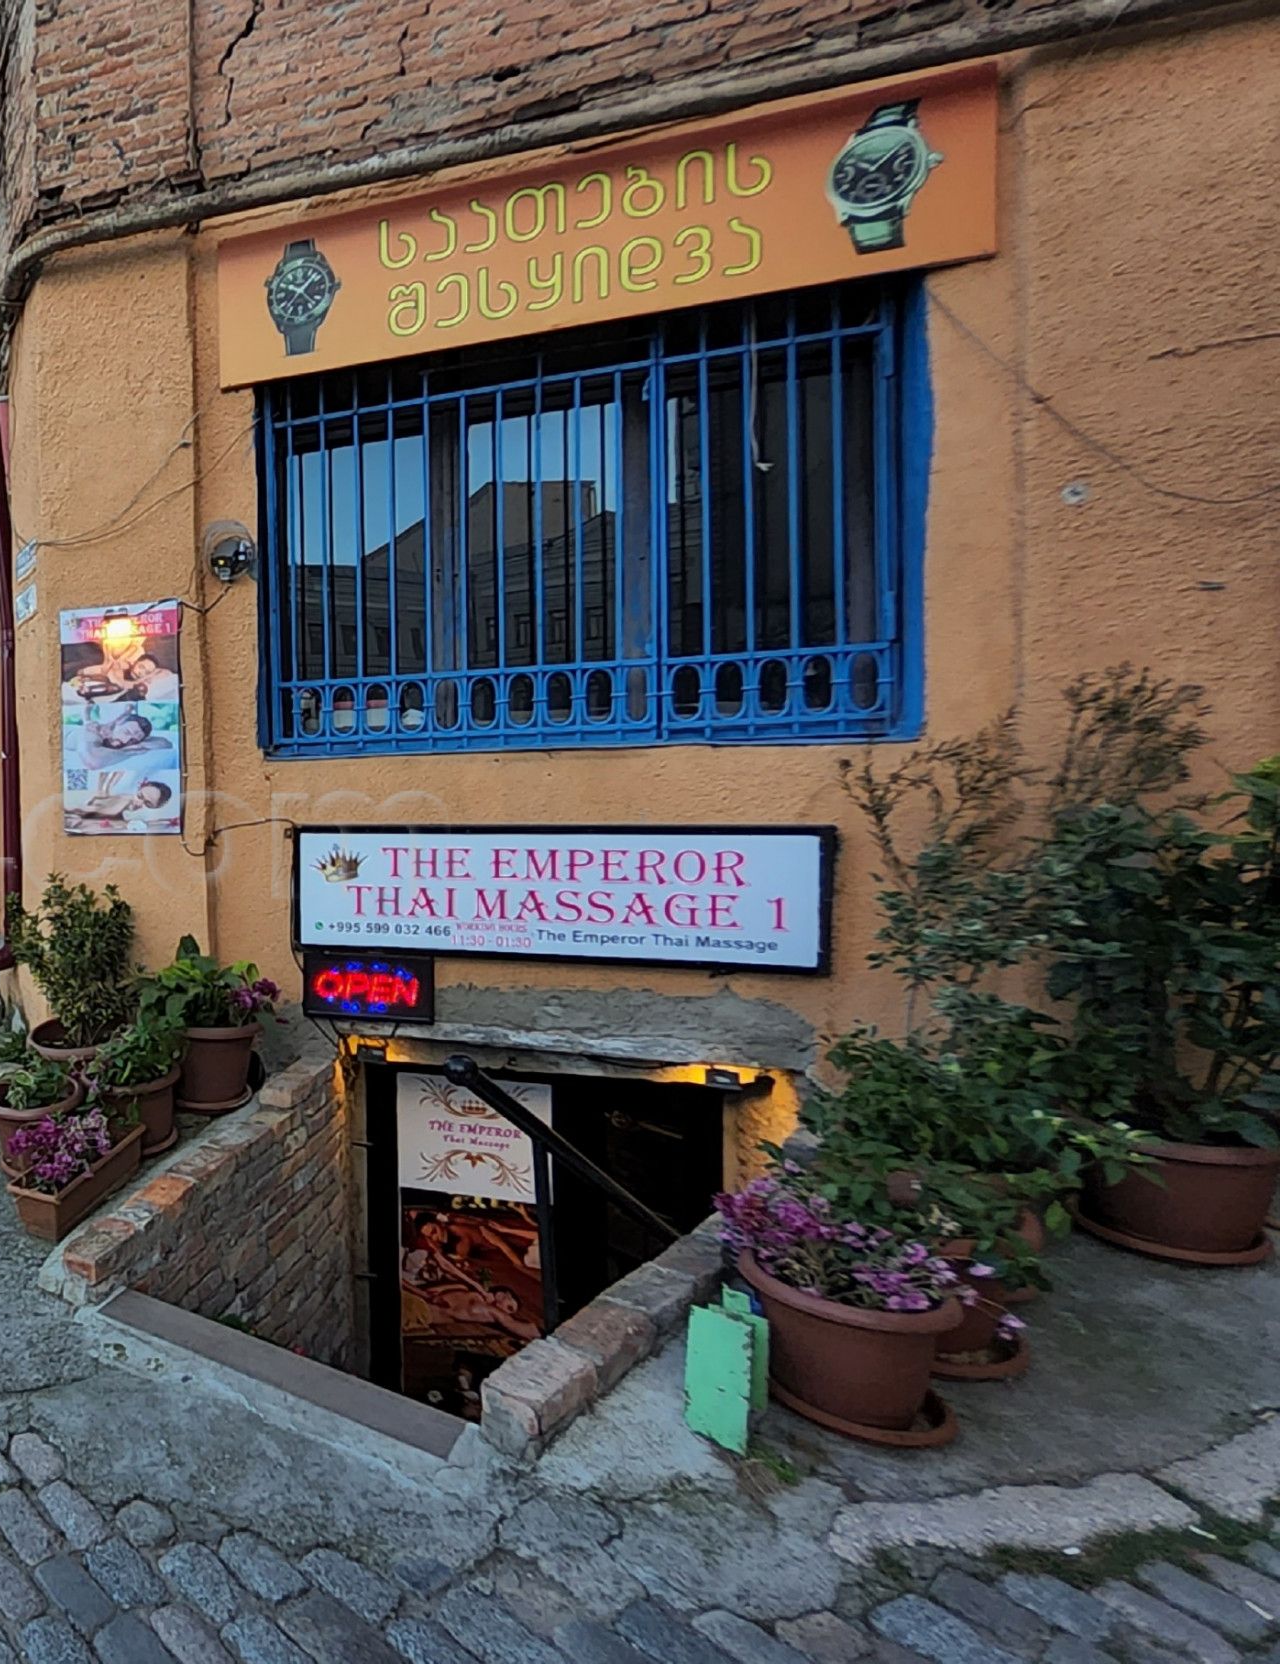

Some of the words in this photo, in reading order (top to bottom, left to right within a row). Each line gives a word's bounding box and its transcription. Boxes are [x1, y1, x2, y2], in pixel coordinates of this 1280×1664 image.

[377, 141, 774, 269] საათების
[386, 215, 765, 338] შესყიდვა
[381, 846, 472, 880] THE
[490, 848, 748, 888] EMPEROR
[328, 920, 361, 933] +995
[366, 922, 390, 934] 599
[394, 923, 420, 935] 032
[424, 924, 451, 937] 466
[346, 884, 458, 920] THAI
[475, 887, 743, 931] MASSAGE
[767, 896, 790, 933] 1
[451, 933, 485, 946] 11:30
[537, 929, 567, 942] The
[572, 930, 647, 948] Emperor
[652, 932, 690, 947] Thai
[695, 936, 778, 953] Massage
[314, 968, 418, 1008] OPEN
[428, 1120, 456, 1132] THE
[459, 1123, 522, 1139] EMPEROR
